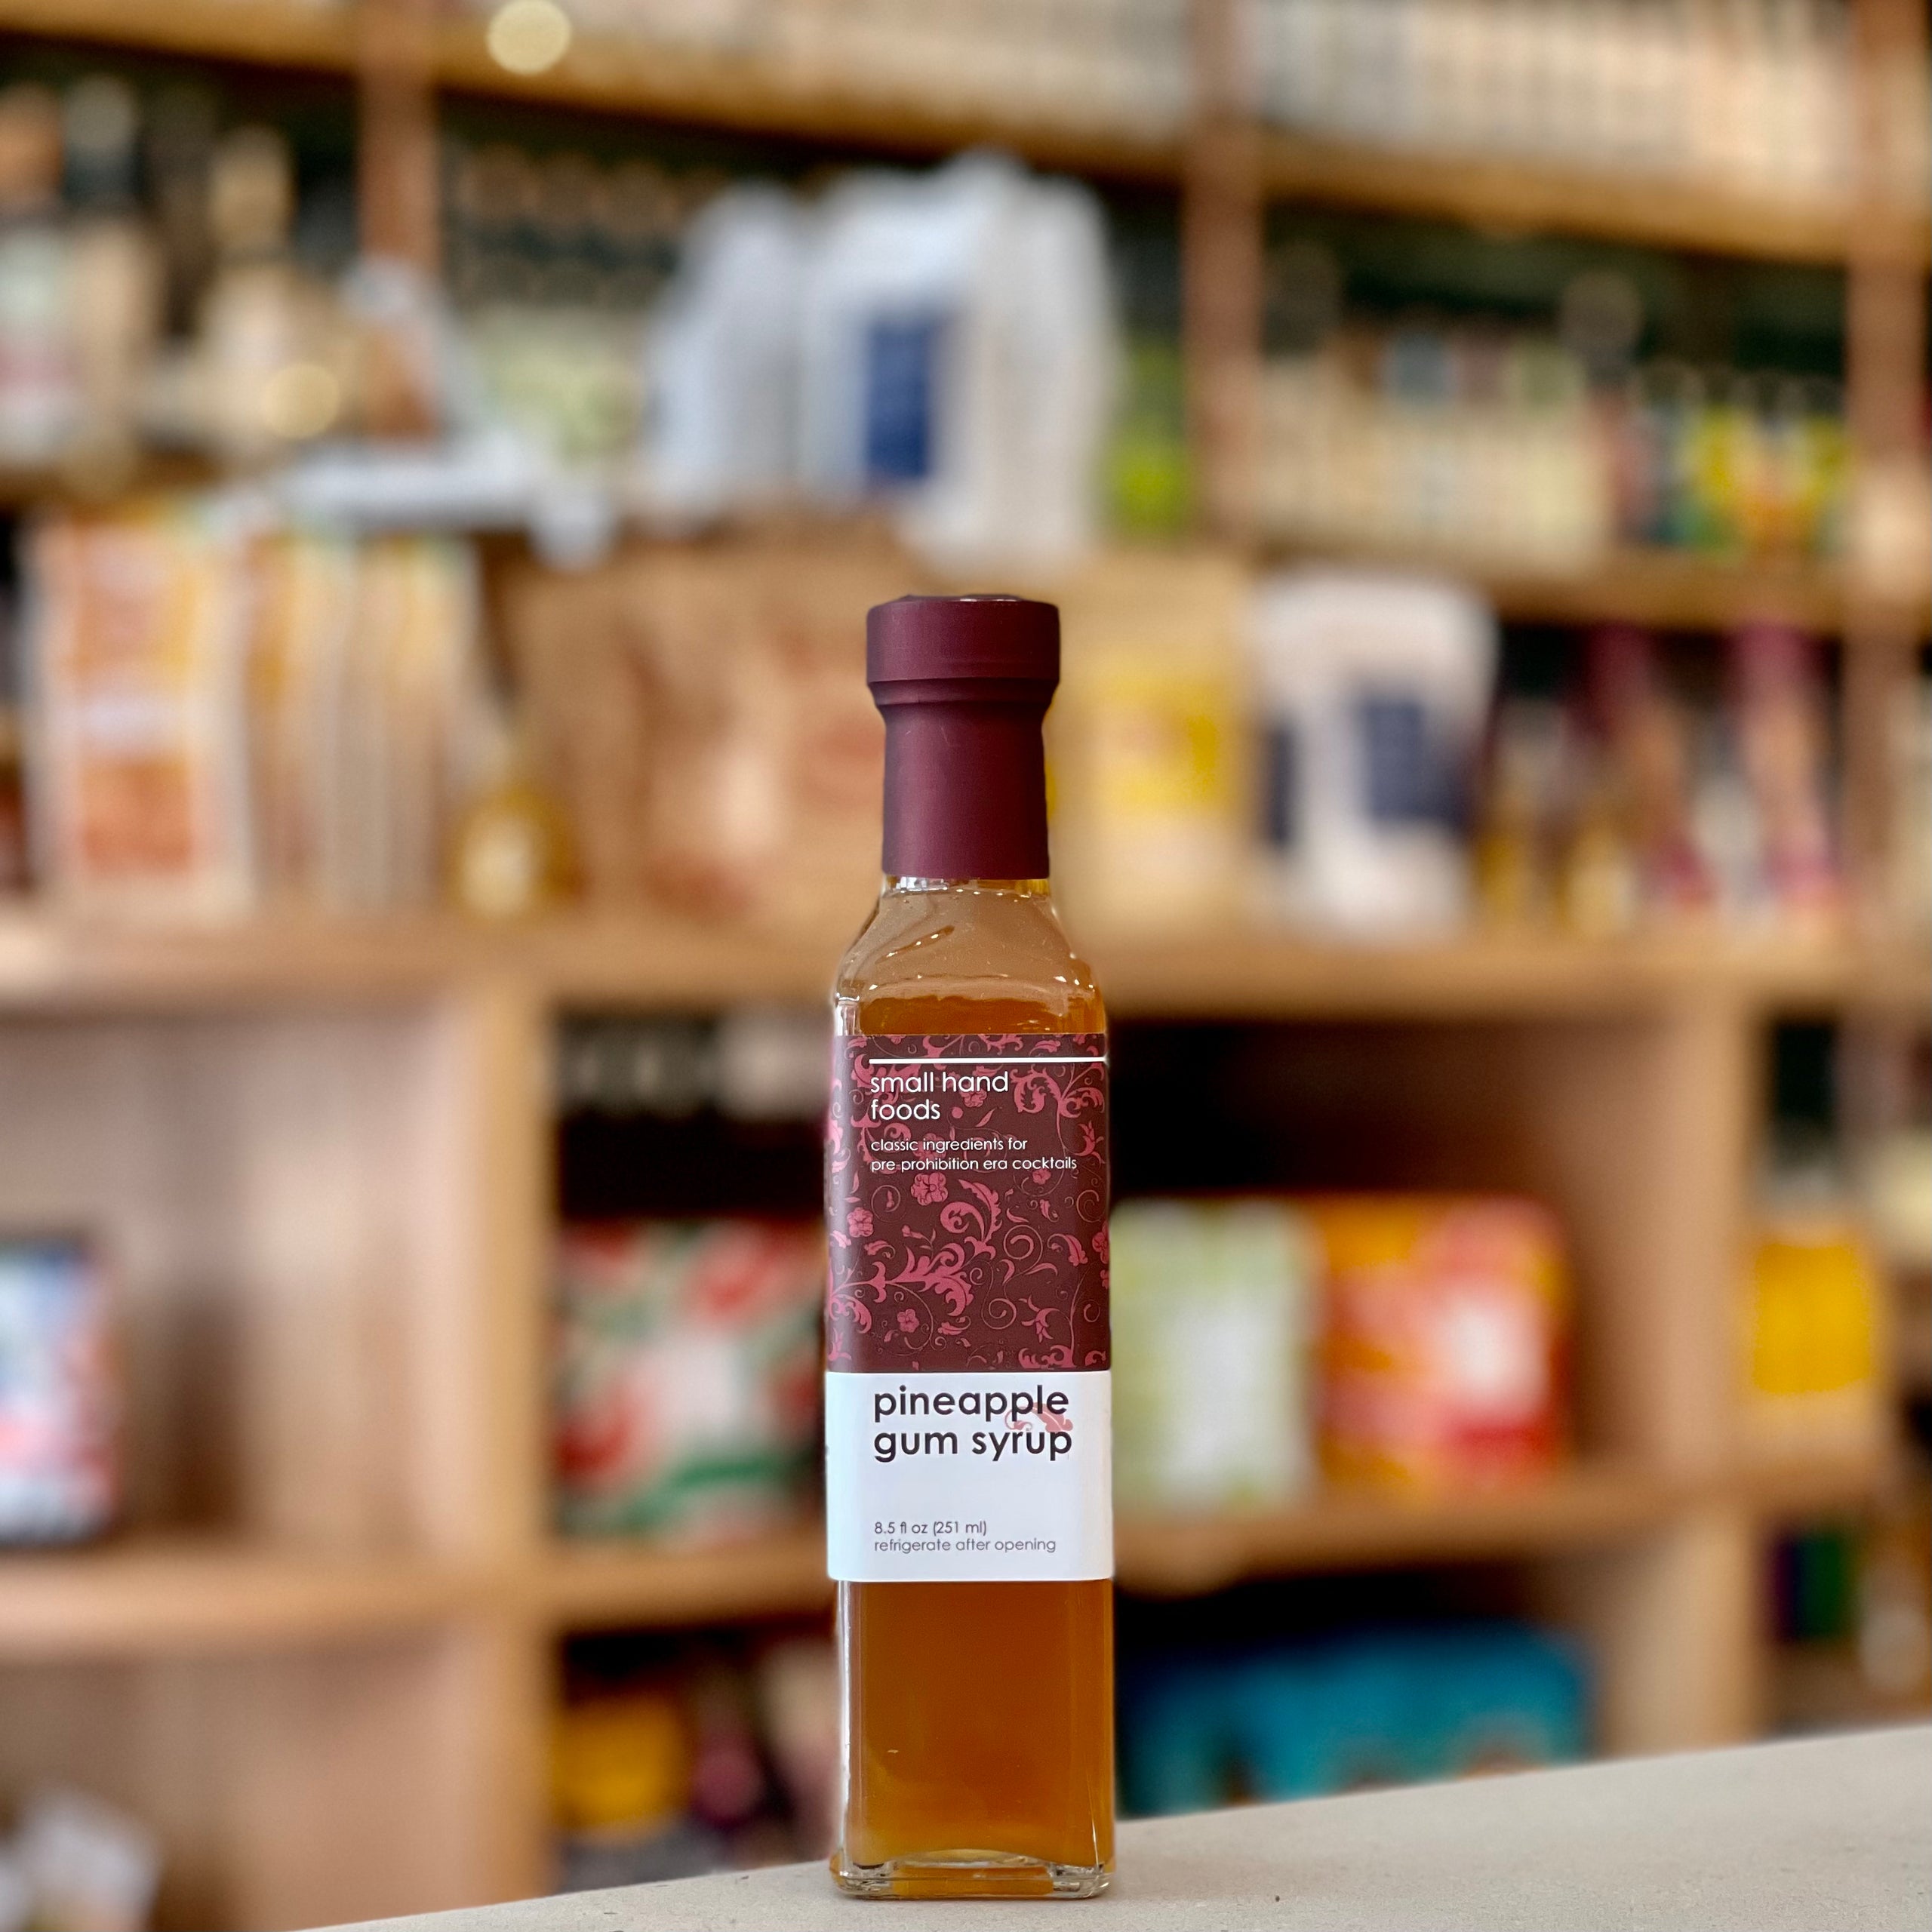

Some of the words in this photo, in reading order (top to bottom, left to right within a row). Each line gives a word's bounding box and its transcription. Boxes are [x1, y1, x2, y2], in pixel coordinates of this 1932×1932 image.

[871, 1072, 934, 1093] small
[942, 1071, 1008, 1092] hand
[871, 1099, 940, 1120] foods
[871, 1139, 918, 1151] classic
[922, 1138, 1004, 1153] ingredients
[1008, 1137, 1027, 1150] for
[983, 1158, 1008, 1170] era
[1012, 1156, 1078, 1170] cocktails
[874, 1384, 1069, 1423] pineapple
[874, 1432, 958, 1463] gum
[971, 1431, 1072, 1462] syrup
[874, 1521, 896, 1534] 8.5
[900, 1521, 907, 1534] fl
[911, 1524, 928, 1534] oz
[933, 1521, 958, 1537] (251
[964, 1521, 987, 1536] ml)
[874, 1540, 951, 1554] refrigerate
[955, 1539, 990, 1552] after
[994, 1538, 1057, 1553] opening
